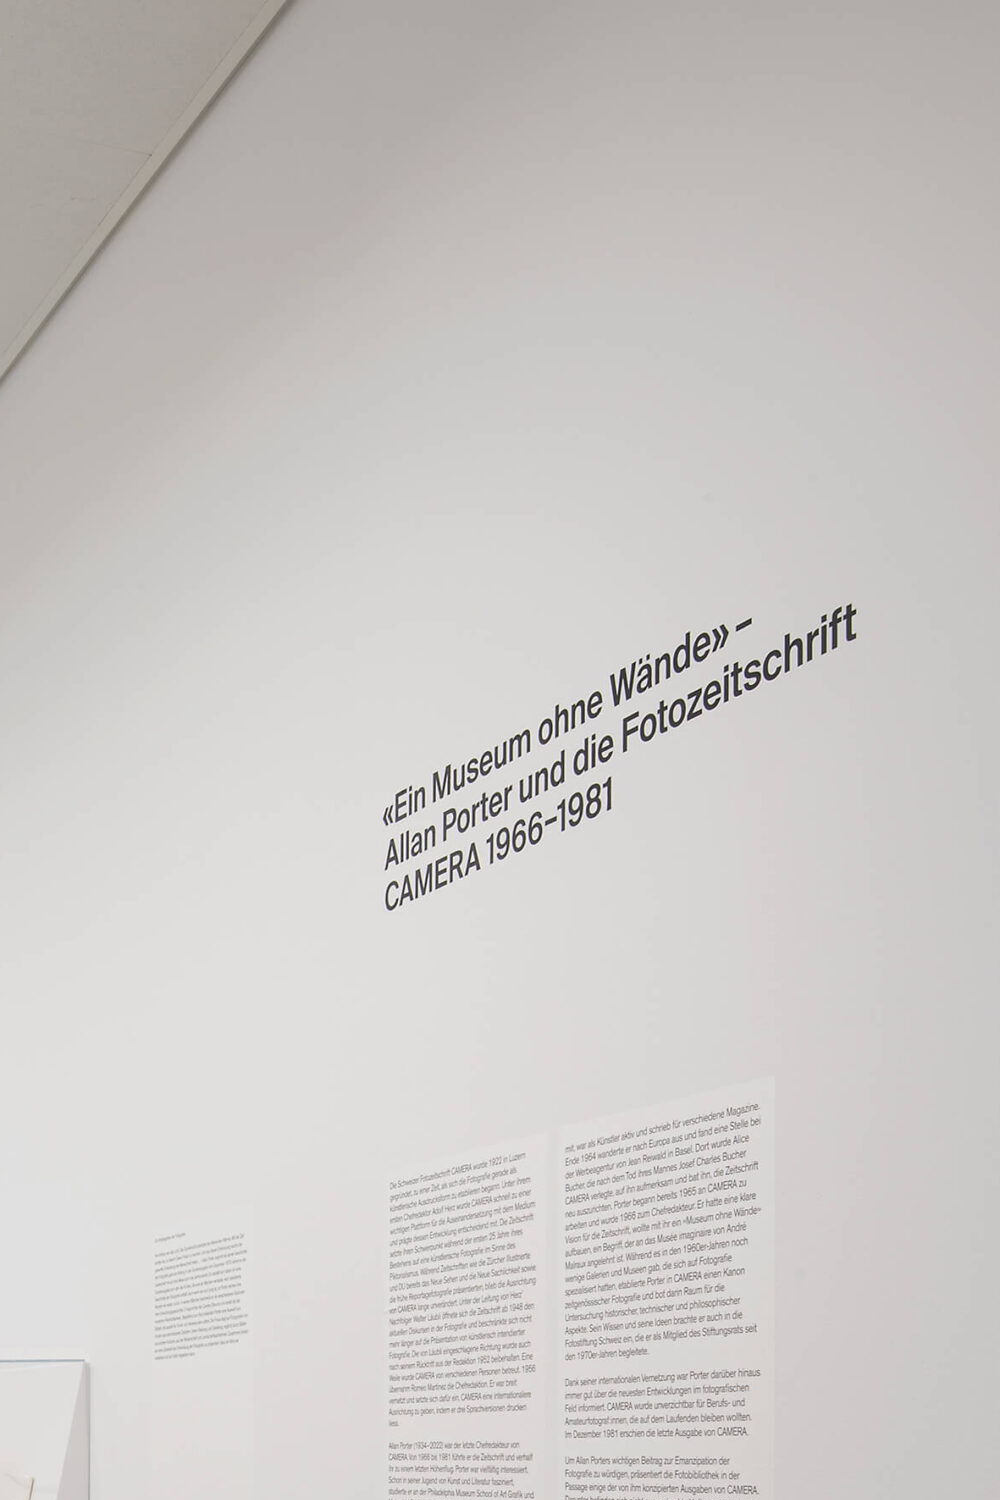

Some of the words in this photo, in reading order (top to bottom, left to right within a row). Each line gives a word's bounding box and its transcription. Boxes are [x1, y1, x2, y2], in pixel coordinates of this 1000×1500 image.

[383, 786, 425, 825] «Ein
[433, 730, 530, 802] Museum
[539, 691, 602, 745] ohne
[610, 624, 729, 706] Wände»
[385, 826, 435, 870] Allan
[443, 785, 512, 841] Porter
[520, 750, 565, 802] und
[574, 734, 613, 775] die
[623, 604, 856, 752] Fotozeitschrift
[386, 843, 480, 910] CAMERA
[487, 777, 611, 864] 1966–1981
[648, 1121, 671, 1135] schrieb
[682, 1111, 725, 1127] verschiedene
[726, 1103, 761, 1117] Magazine.
[648, 1137, 671, 1149] Europa
[684, 1129, 697, 1141] und
[698, 1126, 713, 1137] fand
[714, 1124, 728, 1134] eine
[729, 1119, 748, 1131] Stelle
[750, 1115, 760, 1126] bei
[642, 1150, 666, 1163] Reiwald
[695, 1141, 709, 1152] Dort
[711, 1137, 731, 1149] wurde
[733, 1134, 750, 1144] Alice
[653, 1164, 677, 1175] Mannes
[678, 1158, 695, 1170] Josef
[696, 1154, 721, 1166] Charles
[722, 1149, 746, 1161] Bucher
[636, 1179, 673, 1192] aufmerksam
[688, 1172, 699, 1182] bat
[713, 1167, 724, 1177] die
[725, 1160, 758, 1175] Zeitschrift
[657, 1191, 678, 1202] bereits
[679, 1187, 696, 1198] 1965
[707, 1178, 738, 1193] CAMERA
[706, 1197, 722, 1207] hatte
[724, 1194, 738, 1204] eine
[739, 1192, 756, 1201] klare
[715, 1210, 732, 1220] ohne
[657, 1232, 678, 1243] Musée
[679, 1227, 712, 1240] imaginaire
[713, 1226, 725, 1235] von
[727, 1221, 747, 1233] André
[625, 1250, 652, 1262] Während
[683, 1240, 730, 1253] 1960er-Jahren
[731, 1235, 748, 1246] noch
[673, 1259, 686, 1269] sich
[687, 1257, 698, 1267] auf
[699, 1253, 732, 1265] Fotografie
[618, 1279, 645, 1290] etablierte
[646, 1277, 665, 1286] Porter
[673, 1271, 703, 1283] CAMERA
[704, 1269, 722, 1279] einen
[723, 1267, 744, 1276] Kanon
[611, 1293, 641, 1304] Fotografie
[666, 1288, 682, 1297] darin
[683, 1287, 703, 1295] Raum
[704, 1284, 713, 1293] für
[714, 1282, 725, 1292] die
[640, 1303, 675, 1314] technischer
[689, 1296, 740, 1311] philosophischer
[655, 1318, 672, 1326] Ideen
[673, 1315, 697, 1325] brachte
[707, 1311, 723, 1321] auch
[732, 1310, 742, 1319] die
[663, 1329, 687, 1341] Mitglied
[689, 1328, 701, 1337] des
[702, 1325, 743, 1337] Stiftungsrats
[745, 1323, 757, 1333] seit
[641, 1374, 675, 1383] Vernetzung
[689, 1371, 709, 1380] Porter
[711, 1369, 736, 1379] darüber
[738, 1368, 761, 1377] hinaus
[618, 1389, 645, 1397] neuesten
[647, 1386, 692, 1396] Entwicklungen
[702, 1383, 749, 1395] fotografischen
[654, 1399, 695, 1409] unverzichtbar
[696, 1399, 705, 1408] für
[706, 1398, 730, 1407] Berufs-
[732, 1397, 745, 1406] und
[666, 1414, 699, 1423] Laufenden
[701, 1413, 725, 1422] bleiben
[619, 1429, 645, 1438] erschien
[657, 1428, 673, 1437] letzte
[675, 1427, 702, 1439] Ausgabe
[612, 1456, 639, 1467] wichtigen
[641, 1456, 662, 1467] Beitrag
[675, 1456, 717, 1467] Emanzipation
[719, 1456, 730, 1465] der
[630, 1470, 662, 1480] präsentiert
[674, 1470, 719, 1479] Fotobibliothek
[728, 1470, 740, 1479] der
[642, 1484, 679, 1494] konzipierten
[680, 1484, 712, 1495] Ausgaben
